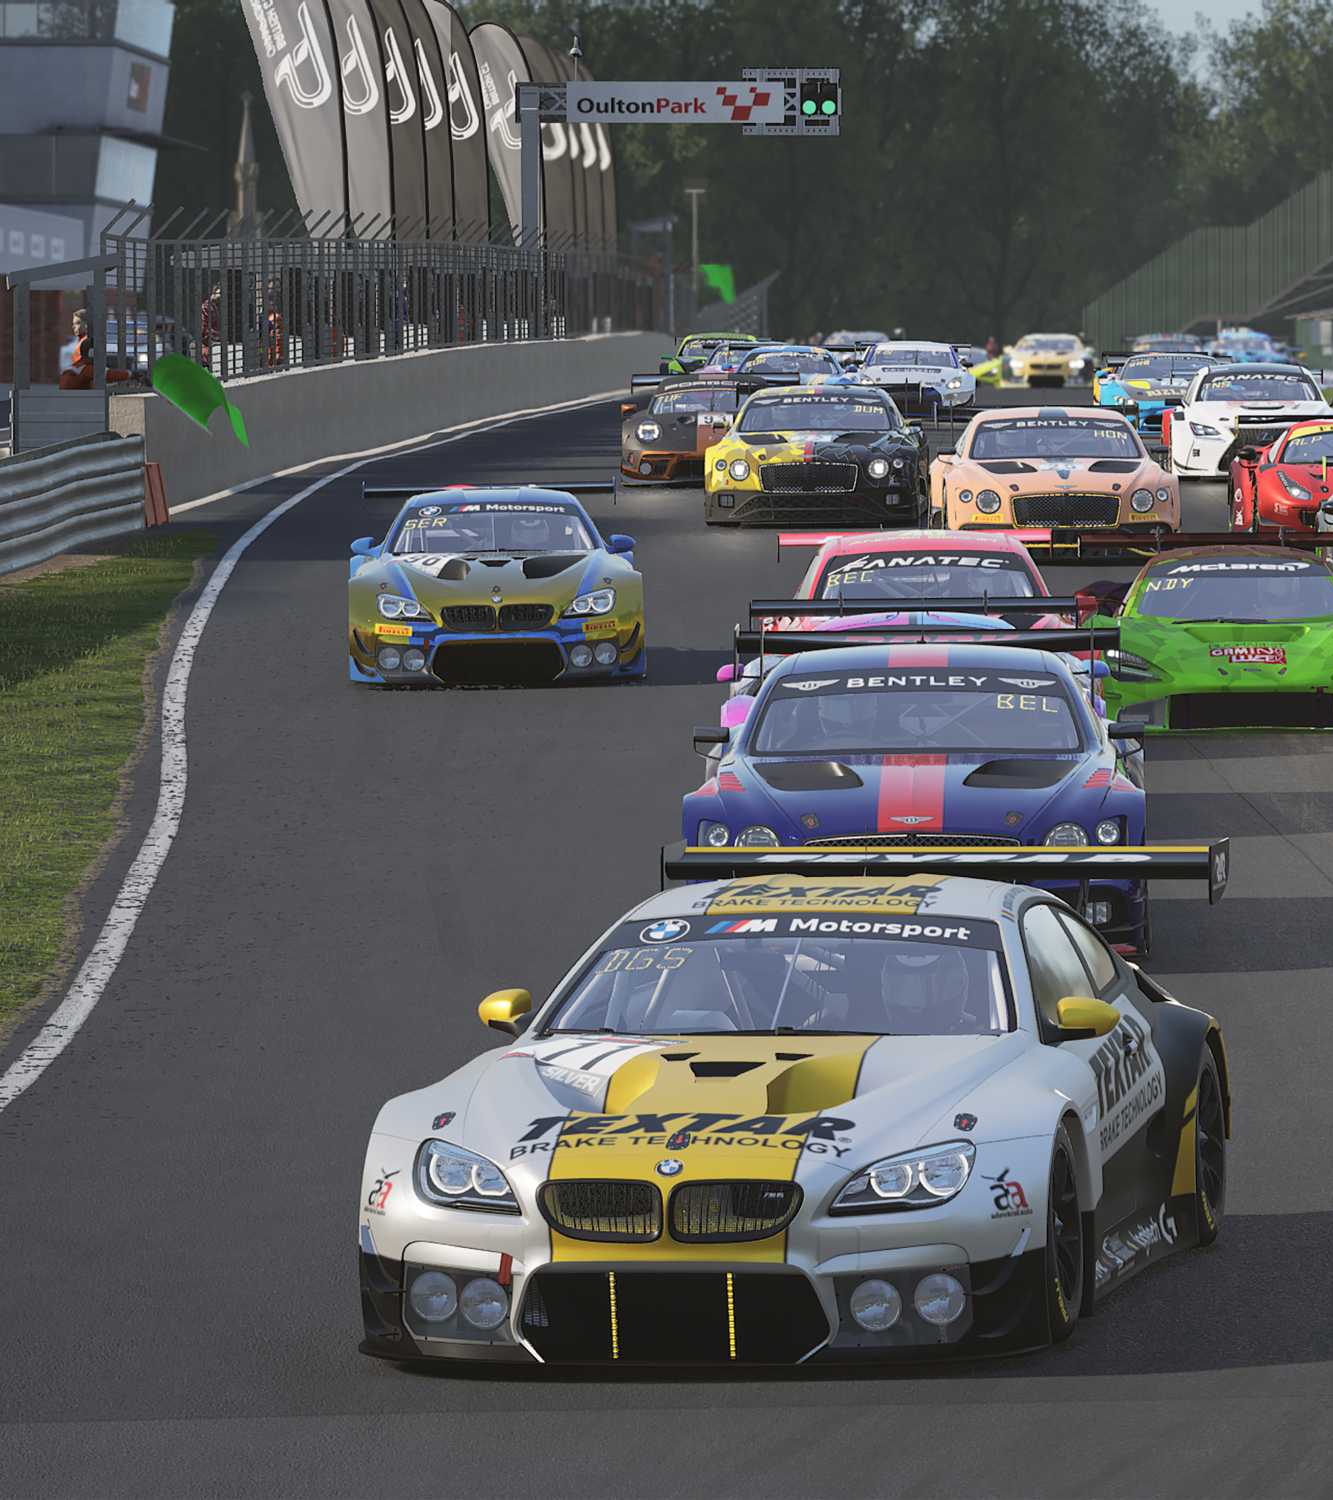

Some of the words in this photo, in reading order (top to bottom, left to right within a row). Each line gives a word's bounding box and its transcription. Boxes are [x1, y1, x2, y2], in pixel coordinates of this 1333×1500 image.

[577, 97, 706, 114] OultonPark
[486, 503, 565, 513] Motorsport
[404, 517, 447, 529] SER
[847, 676, 987, 688] BENTLEY
[692, 899, 777, 909] BRAKE
[780, 899, 937, 909] TECHNOLOGY
[789, 918, 971, 940] Motorsport
[543, 1065, 600, 1094] SILVER
[518, 1112, 855, 1142] TEXTAR
[510, 1135, 616, 1160] BRAKE
[628, 1135, 852, 1159] TEHNOLOGY
